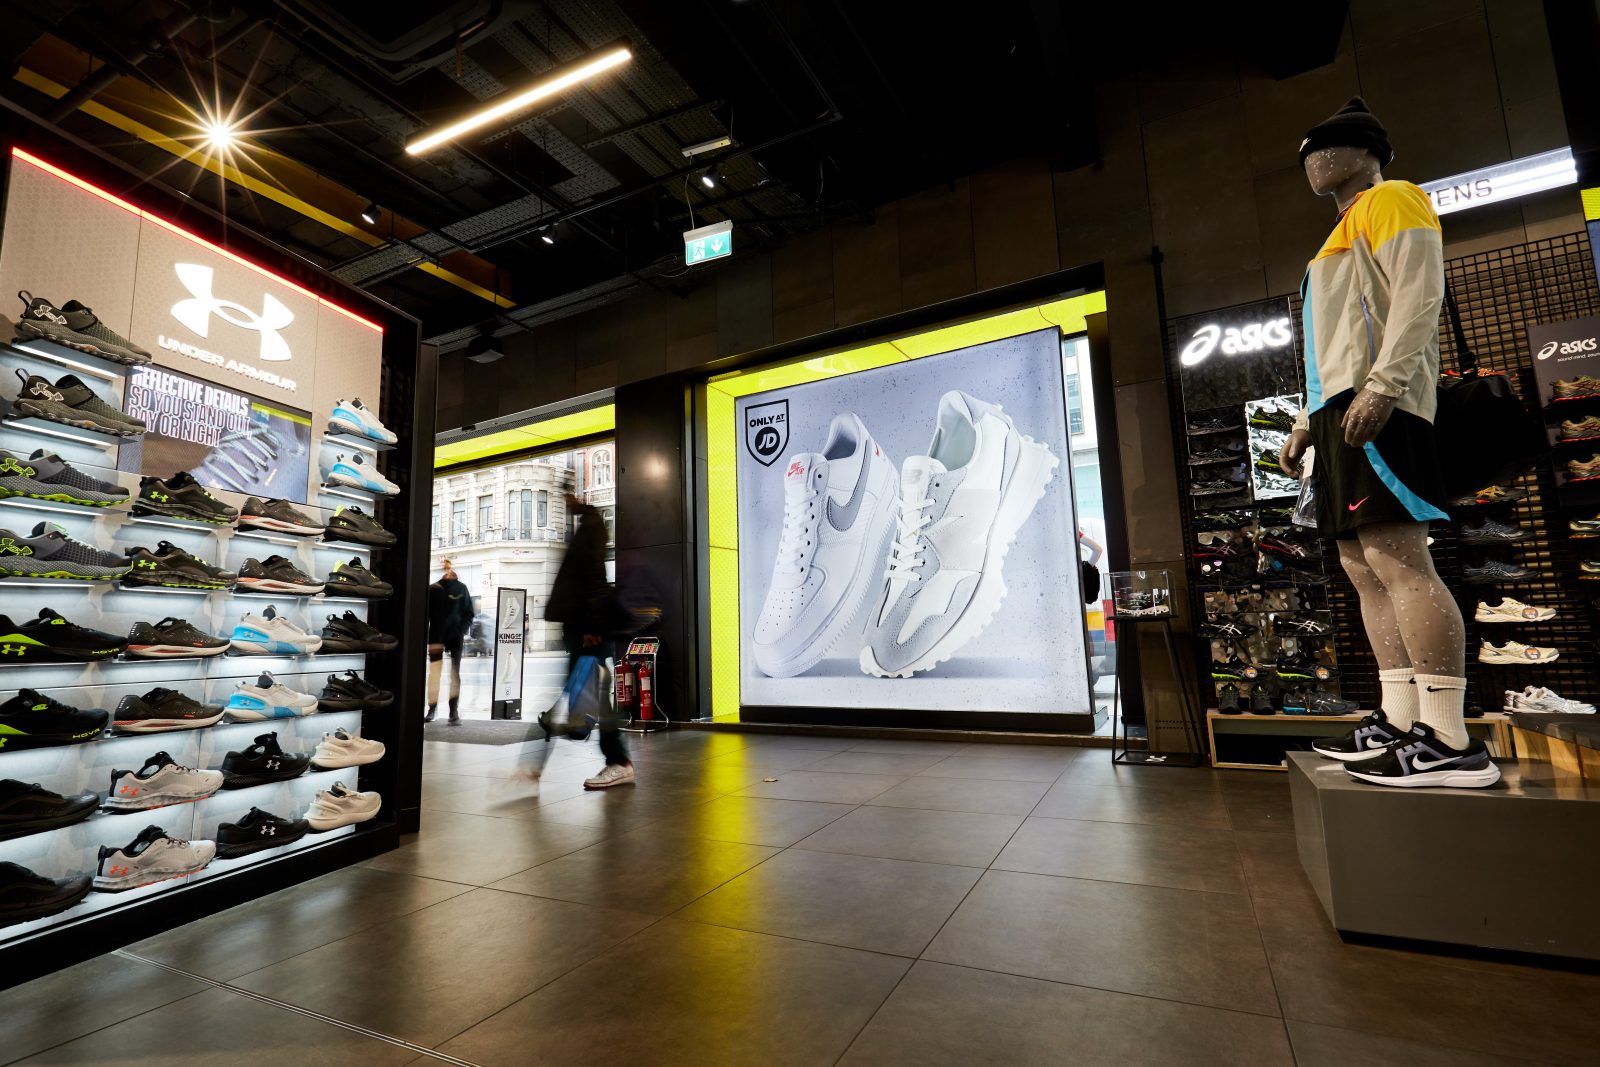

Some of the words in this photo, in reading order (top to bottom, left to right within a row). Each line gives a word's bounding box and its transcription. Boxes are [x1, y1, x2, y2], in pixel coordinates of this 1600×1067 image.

[1426, 179, 1492, 207] ENS
[1560, 338, 1597, 354] asics
[158, 335, 224, 368] UNDER
[225, 359, 297, 392] ARMOUR
[131, 365, 204, 401] REFLECTIVE
[204, 386, 249, 416] DETAILS
[129, 385, 150, 408] SO
[153, 391, 183, 417] YOU
[183, 401, 226, 429] STAND
[749, 415, 774, 428] ONLY
[160, 414, 180, 439] OR
[181, 420, 222, 447] NIGHT
[758, 433, 777, 450] JD
